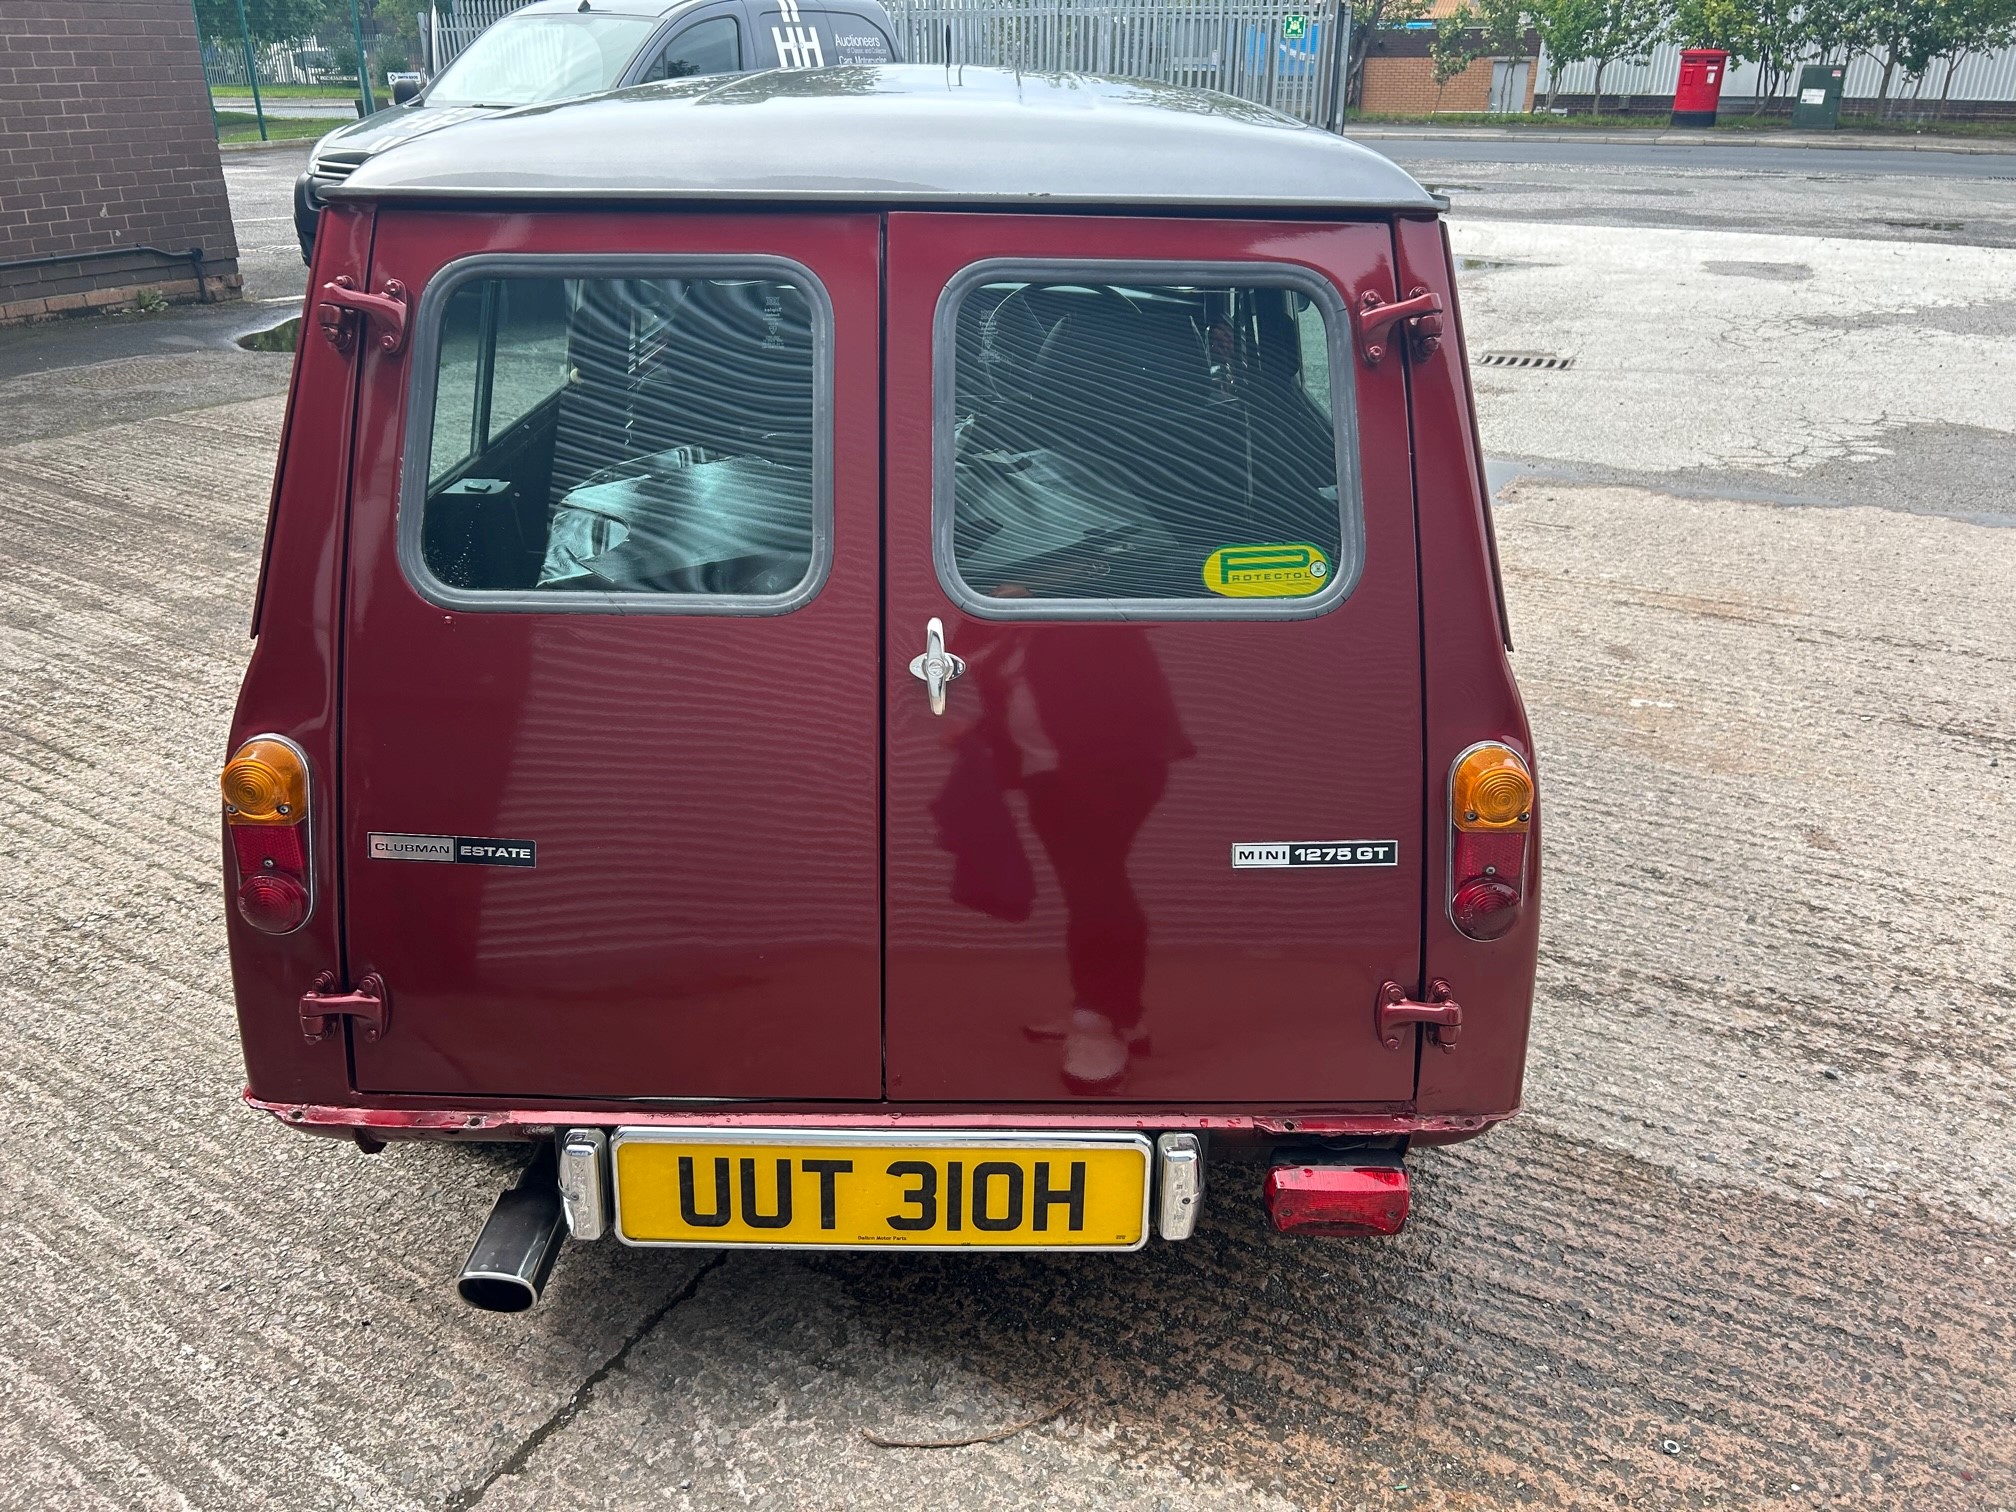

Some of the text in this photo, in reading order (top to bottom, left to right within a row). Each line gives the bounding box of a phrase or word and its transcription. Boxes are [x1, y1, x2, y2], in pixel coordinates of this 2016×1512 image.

[835, 34, 880, 47] Auctioneers
[374, 842, 532, 859] CLUBMAN ESTATE
[1238, 846, 1389, 862] MINI 1275 GT
[678, 1156, 1087, 1232] UUT 310H
